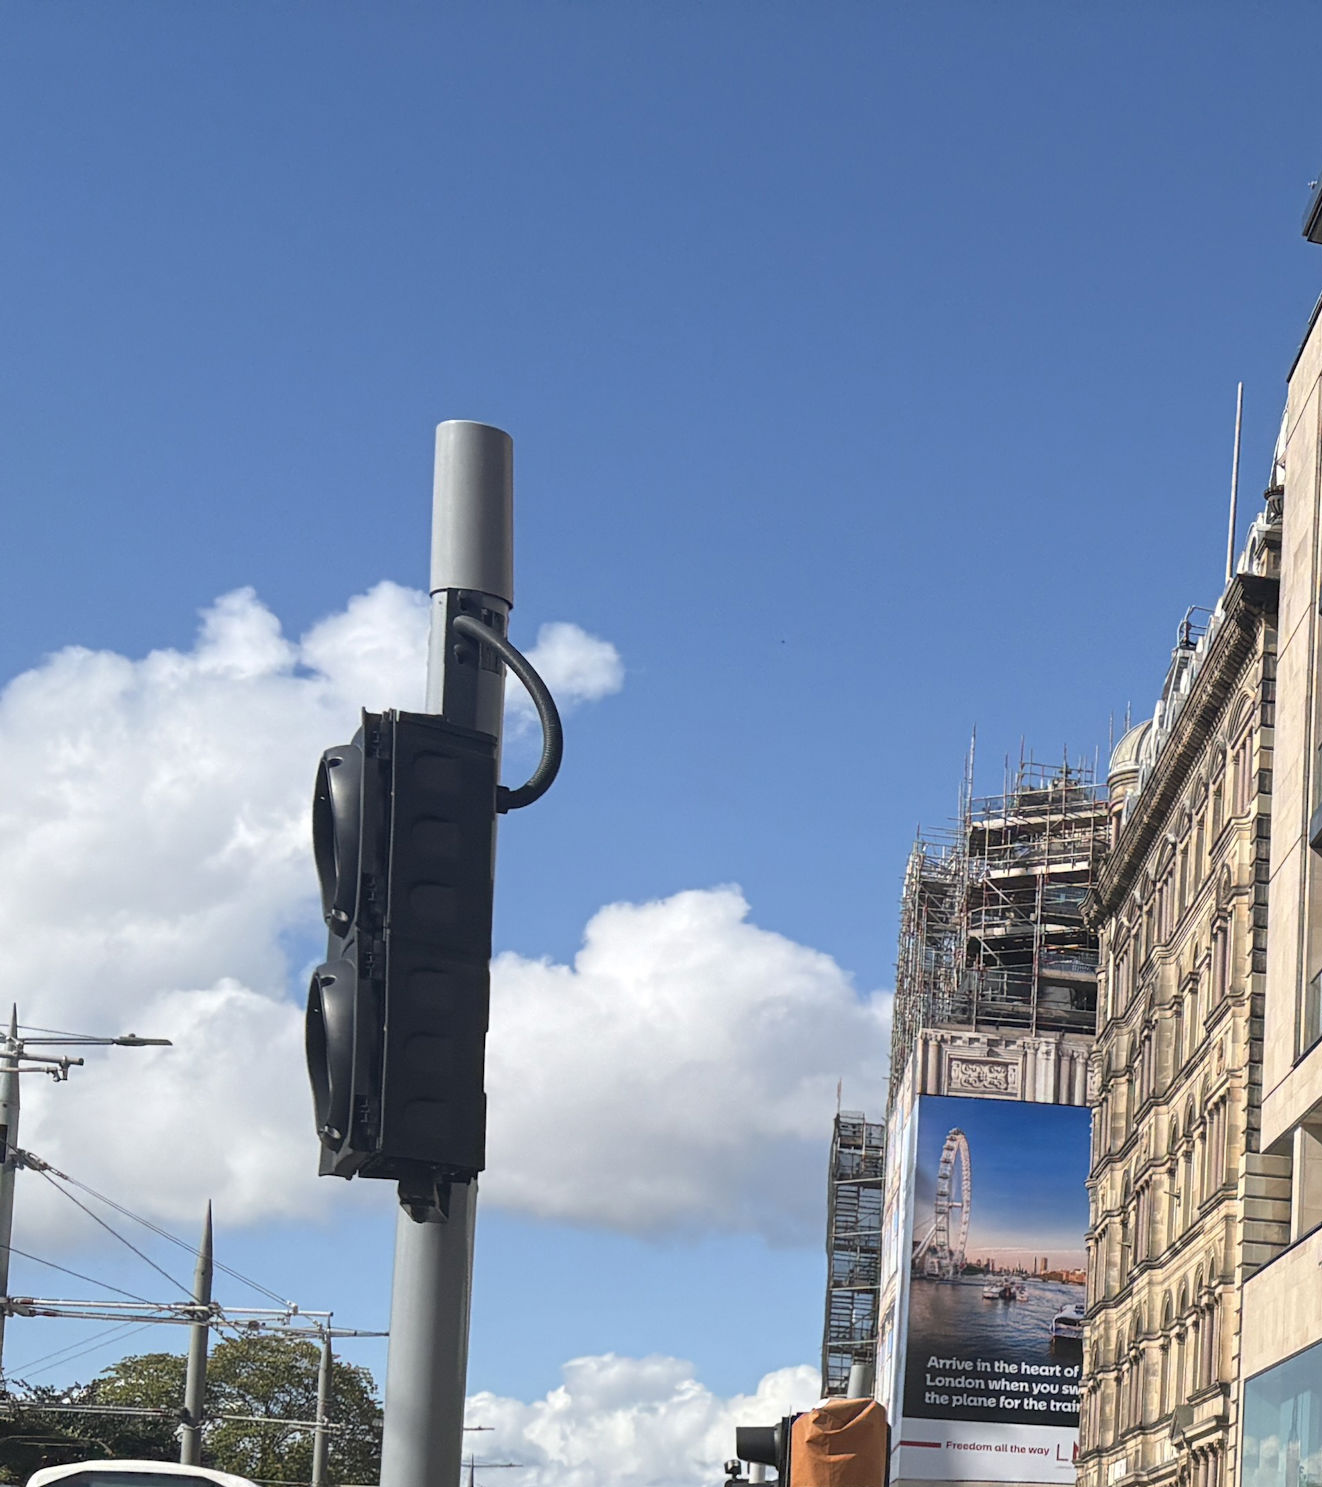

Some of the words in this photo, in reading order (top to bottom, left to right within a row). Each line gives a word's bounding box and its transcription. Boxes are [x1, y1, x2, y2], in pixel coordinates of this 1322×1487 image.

[927, 1356, 974, 1371] Arrive
[976, 1358, 992, 1372] in
[994, 1359, 1018, 1374] the
[1021, 1362, 1061, 1377] heart
[1063, 1365, 1080, 1378] of
[925, 1374, 985, 1390] London
[987, 1379, 1029, 1392] when
[1032, 1382, 1059, 1395] you
[1062, 1384, 1081, 1396] sw
[924, 1391, 950, 1405] the
[952, 1393, 996, 1408] plane
[999, 1396, 1021, 1409] for
[1023, 1398, 1047, 1411] the
[946, 1441, 992, 1453] Freedom
[994, 1444, 1008, 1454] all
[1010, 1445, 1026, 1454] the
[1028, 1446, 1050, 1457] way
